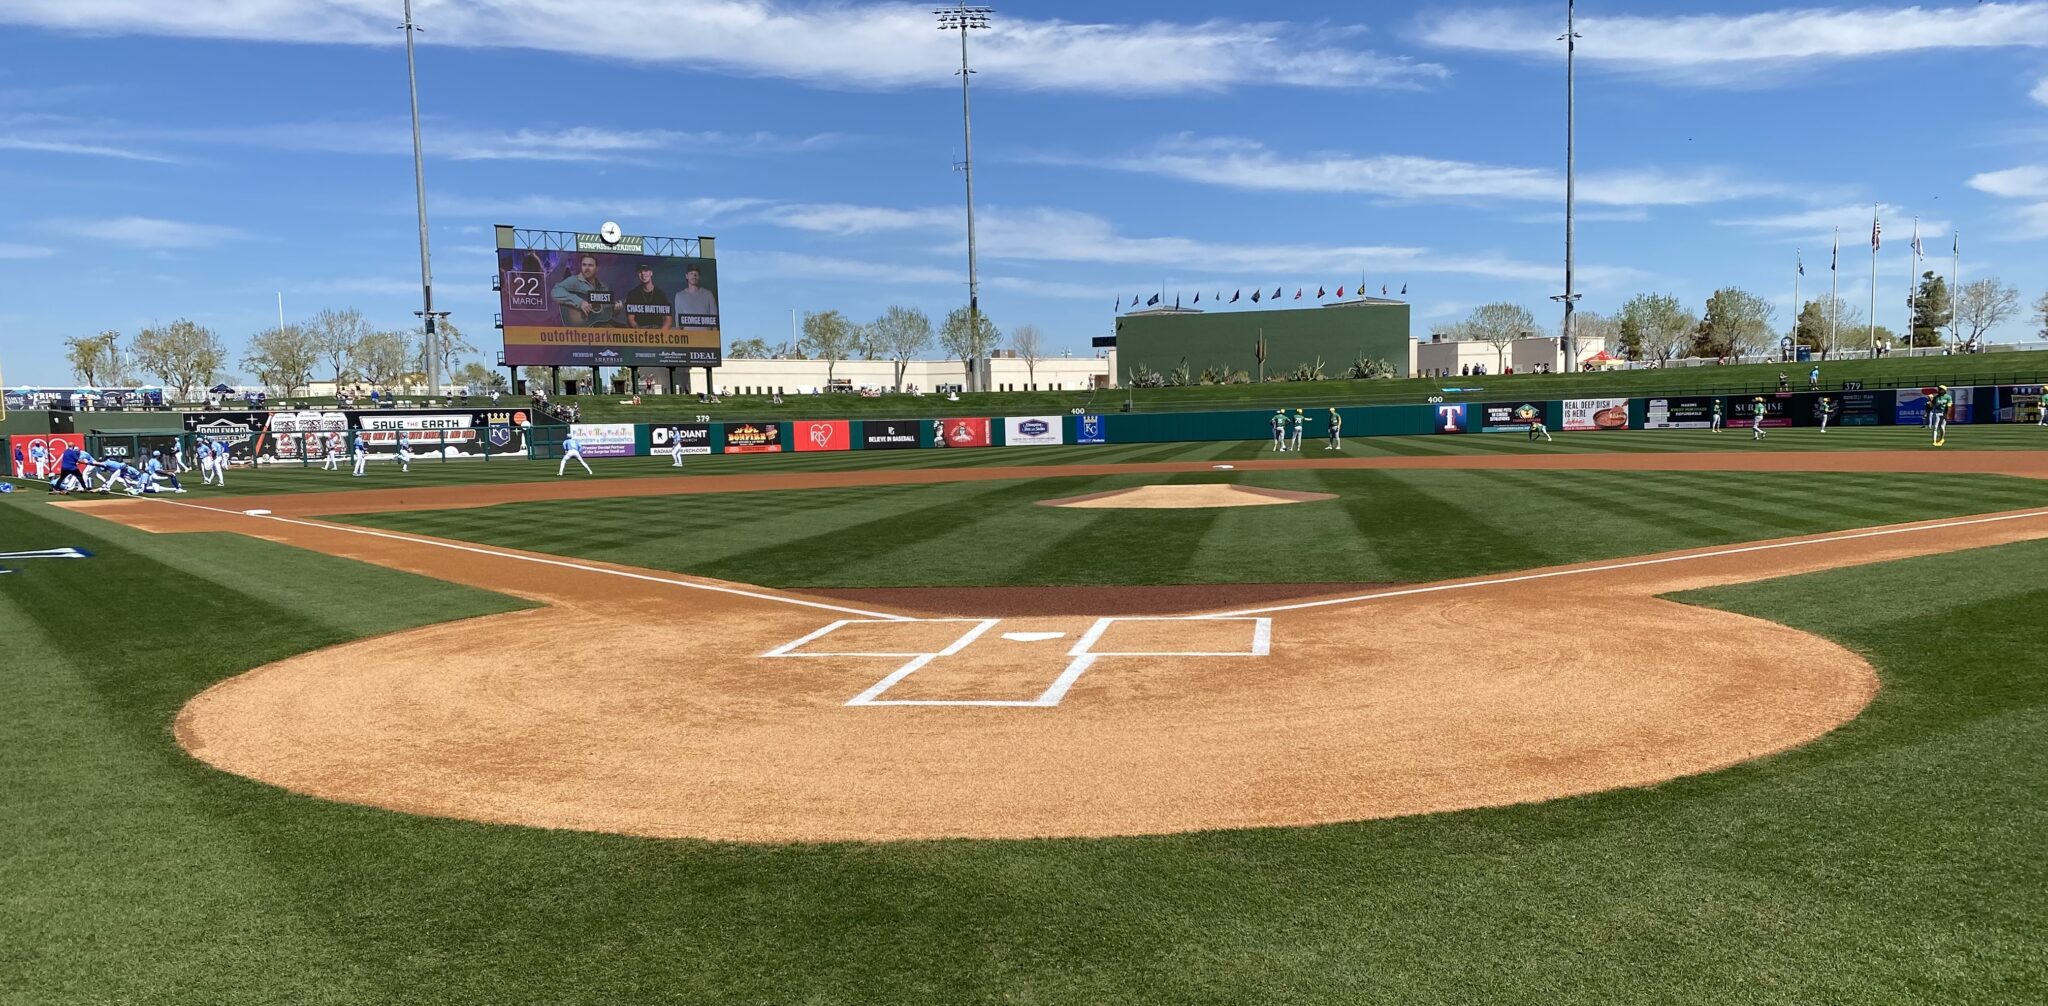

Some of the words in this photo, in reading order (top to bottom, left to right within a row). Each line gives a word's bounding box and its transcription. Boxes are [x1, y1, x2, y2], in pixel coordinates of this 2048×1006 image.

[514, 277, 540, 296] 22
[590, 293, 610, 302] ERNEST
[626, 304, 644, 313] CHASE
[645, 305, 670, 314] MATTHEW
[681, 316, 701, 324] GEORGE
[540, 329, 689, 345] outoftheparkmusicfest.com
[1565, 401, 1578, 409] REAL
[1581, 401, 1594, 409] DEEP
[1596, 400, 1610, 408] DISH
[1439, 406, 1462, 431] T
[372, 420, 404, 429] SAVE
[422, 419, 459, 428] EARTH
[1085, 424, 1097, 434] KC
[668, 430, 707, 438] RDIANT
[105, 447, 127, 456] 350
